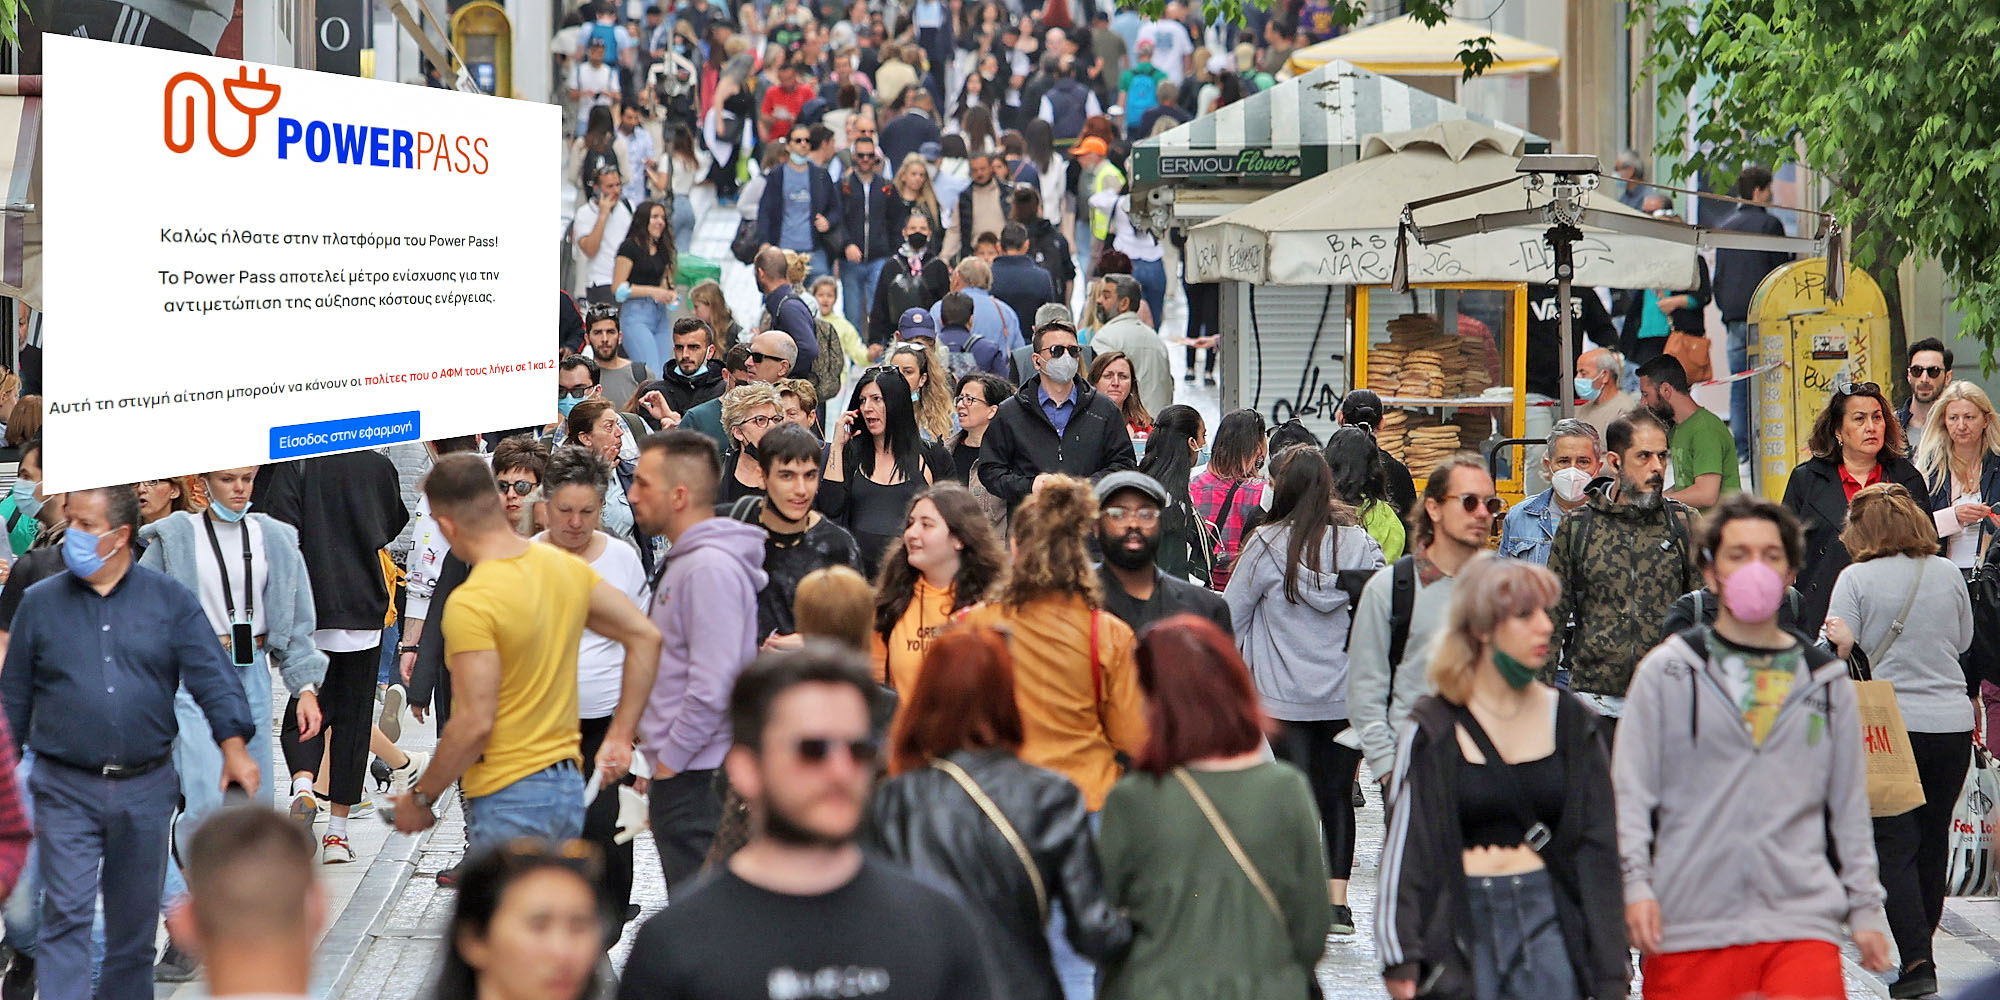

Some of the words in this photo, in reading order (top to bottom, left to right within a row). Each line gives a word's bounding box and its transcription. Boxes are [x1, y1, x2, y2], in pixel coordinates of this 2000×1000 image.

[1161, 158, 1233, 173] ERMOU
[1236, 150, 1298, 172] Flower
[1530, 296, 1583, 322] VAS
